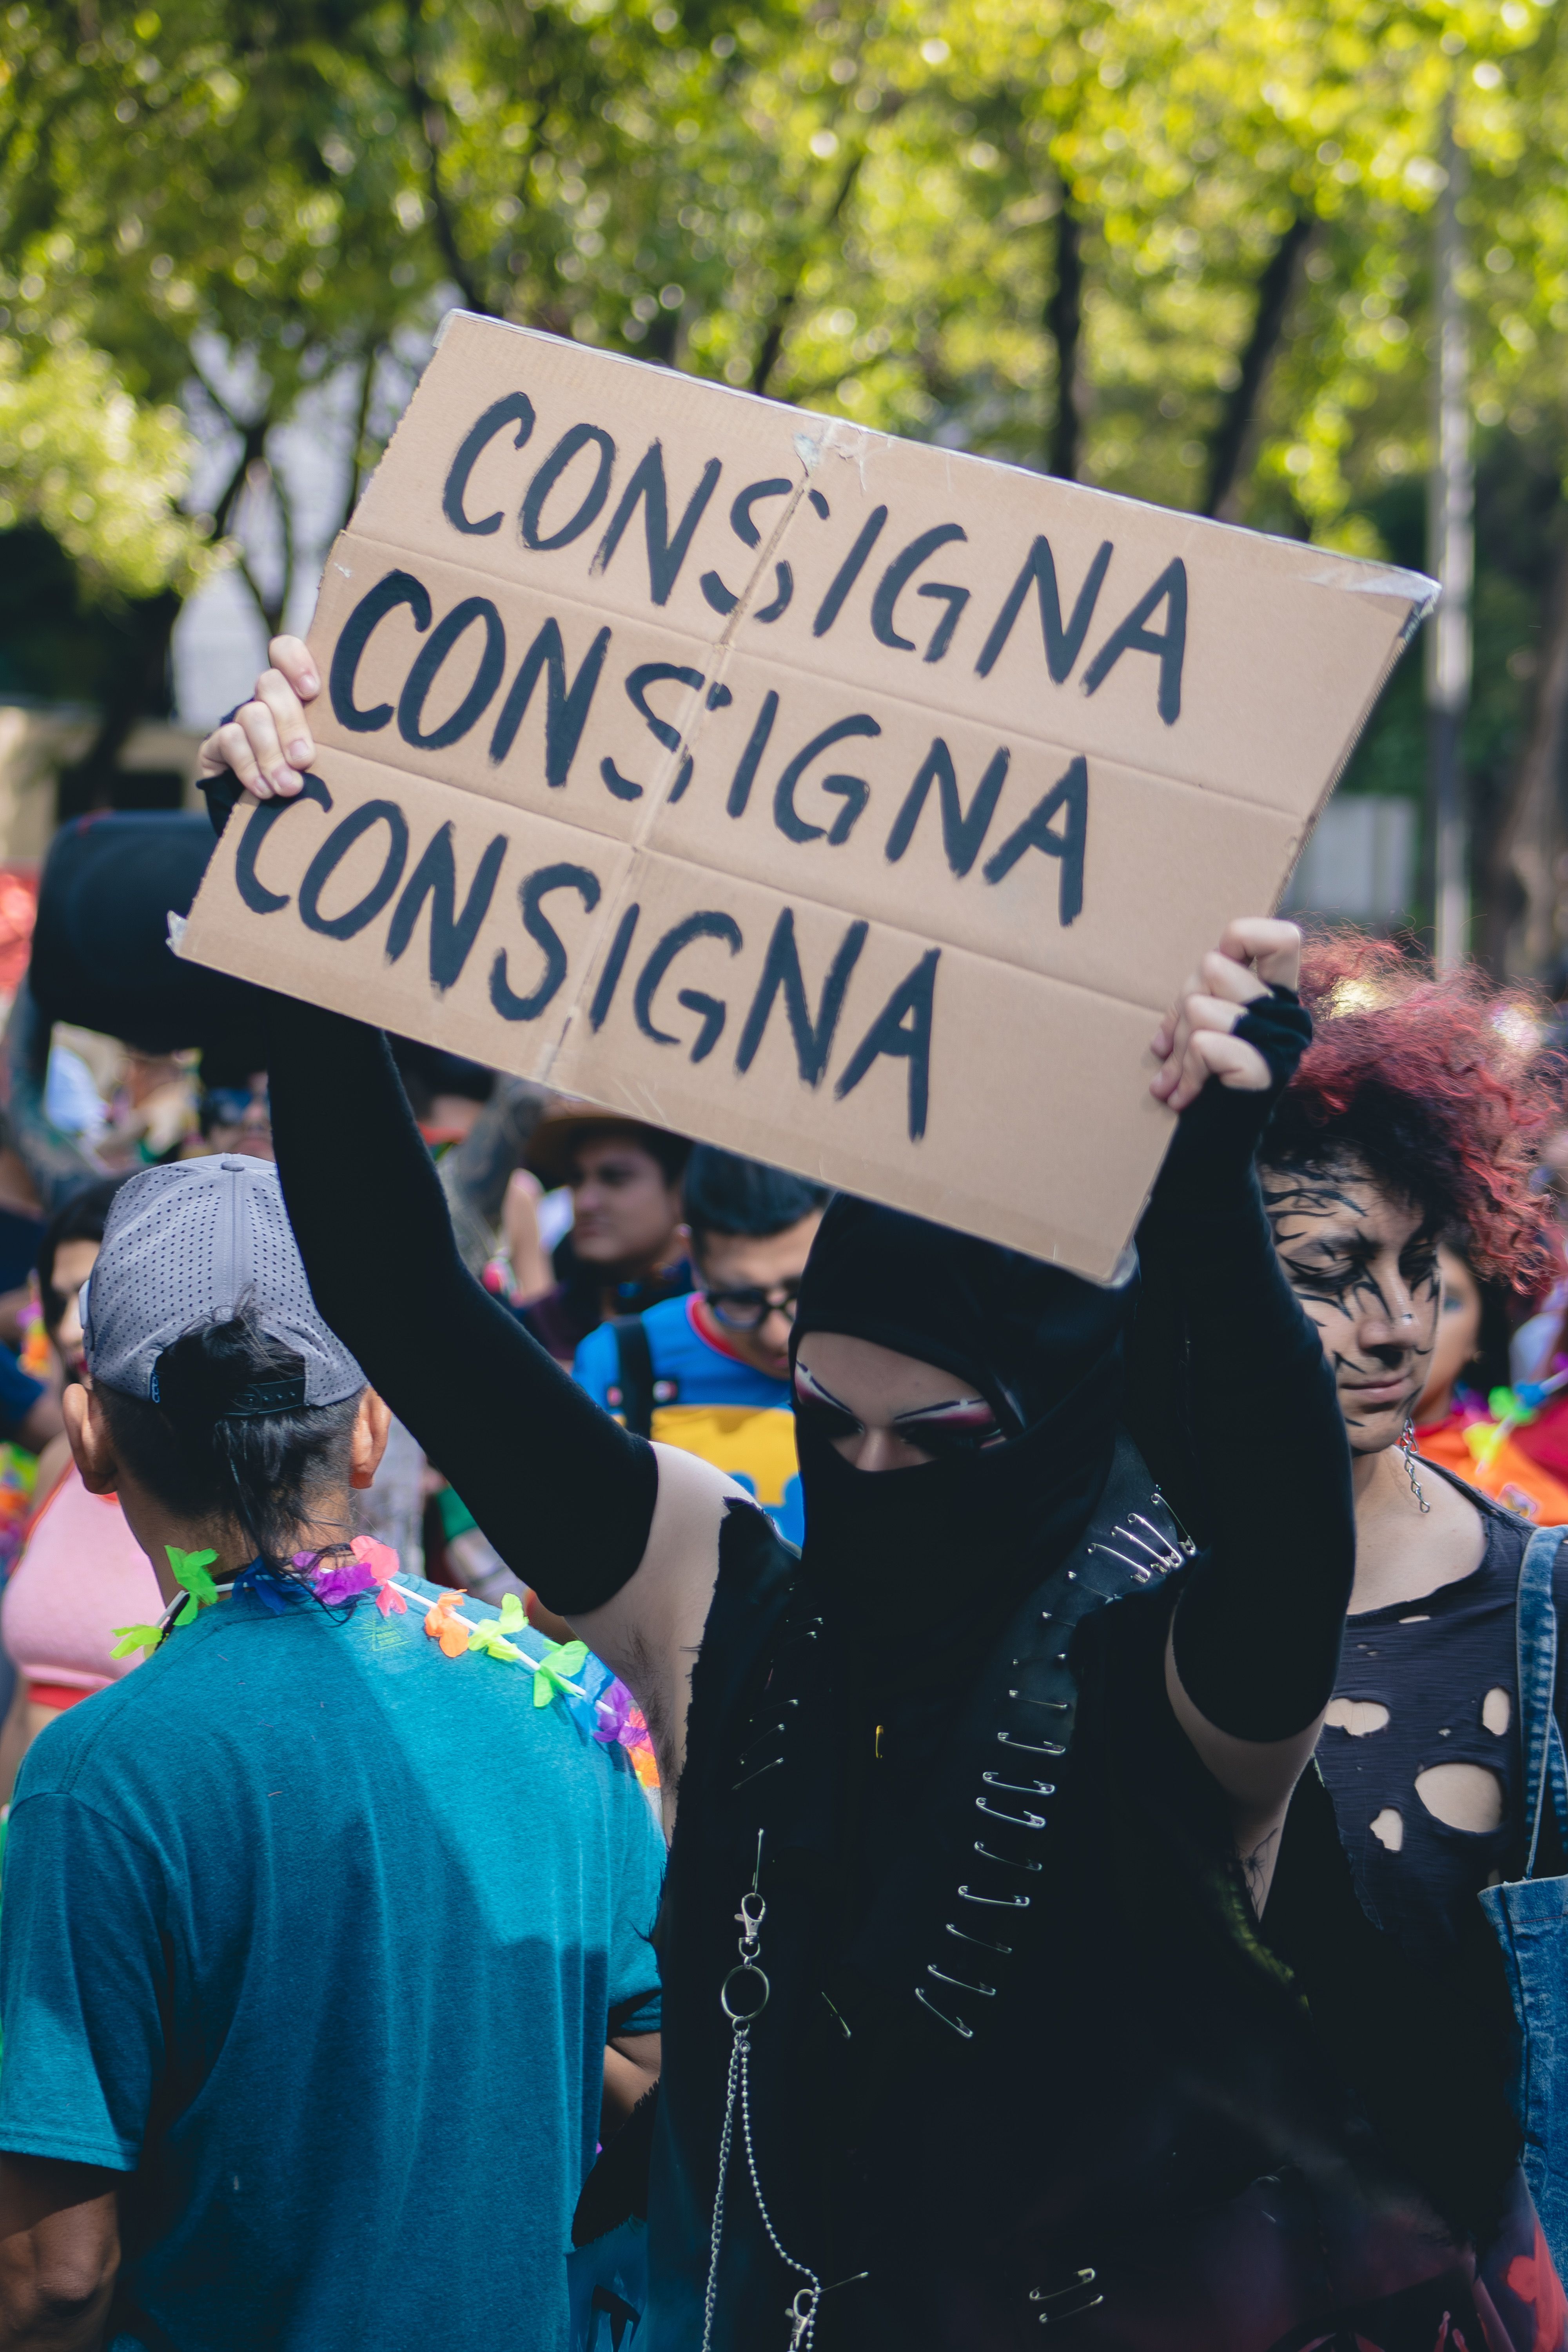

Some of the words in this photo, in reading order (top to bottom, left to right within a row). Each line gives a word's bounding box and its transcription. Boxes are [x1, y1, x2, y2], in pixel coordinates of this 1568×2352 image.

[442, 391, 1187, 726] CONSIGNA
[330, 568, 1087, 925] CONSIGNA
[236, 771, 940, 1140] CONSIGNA
